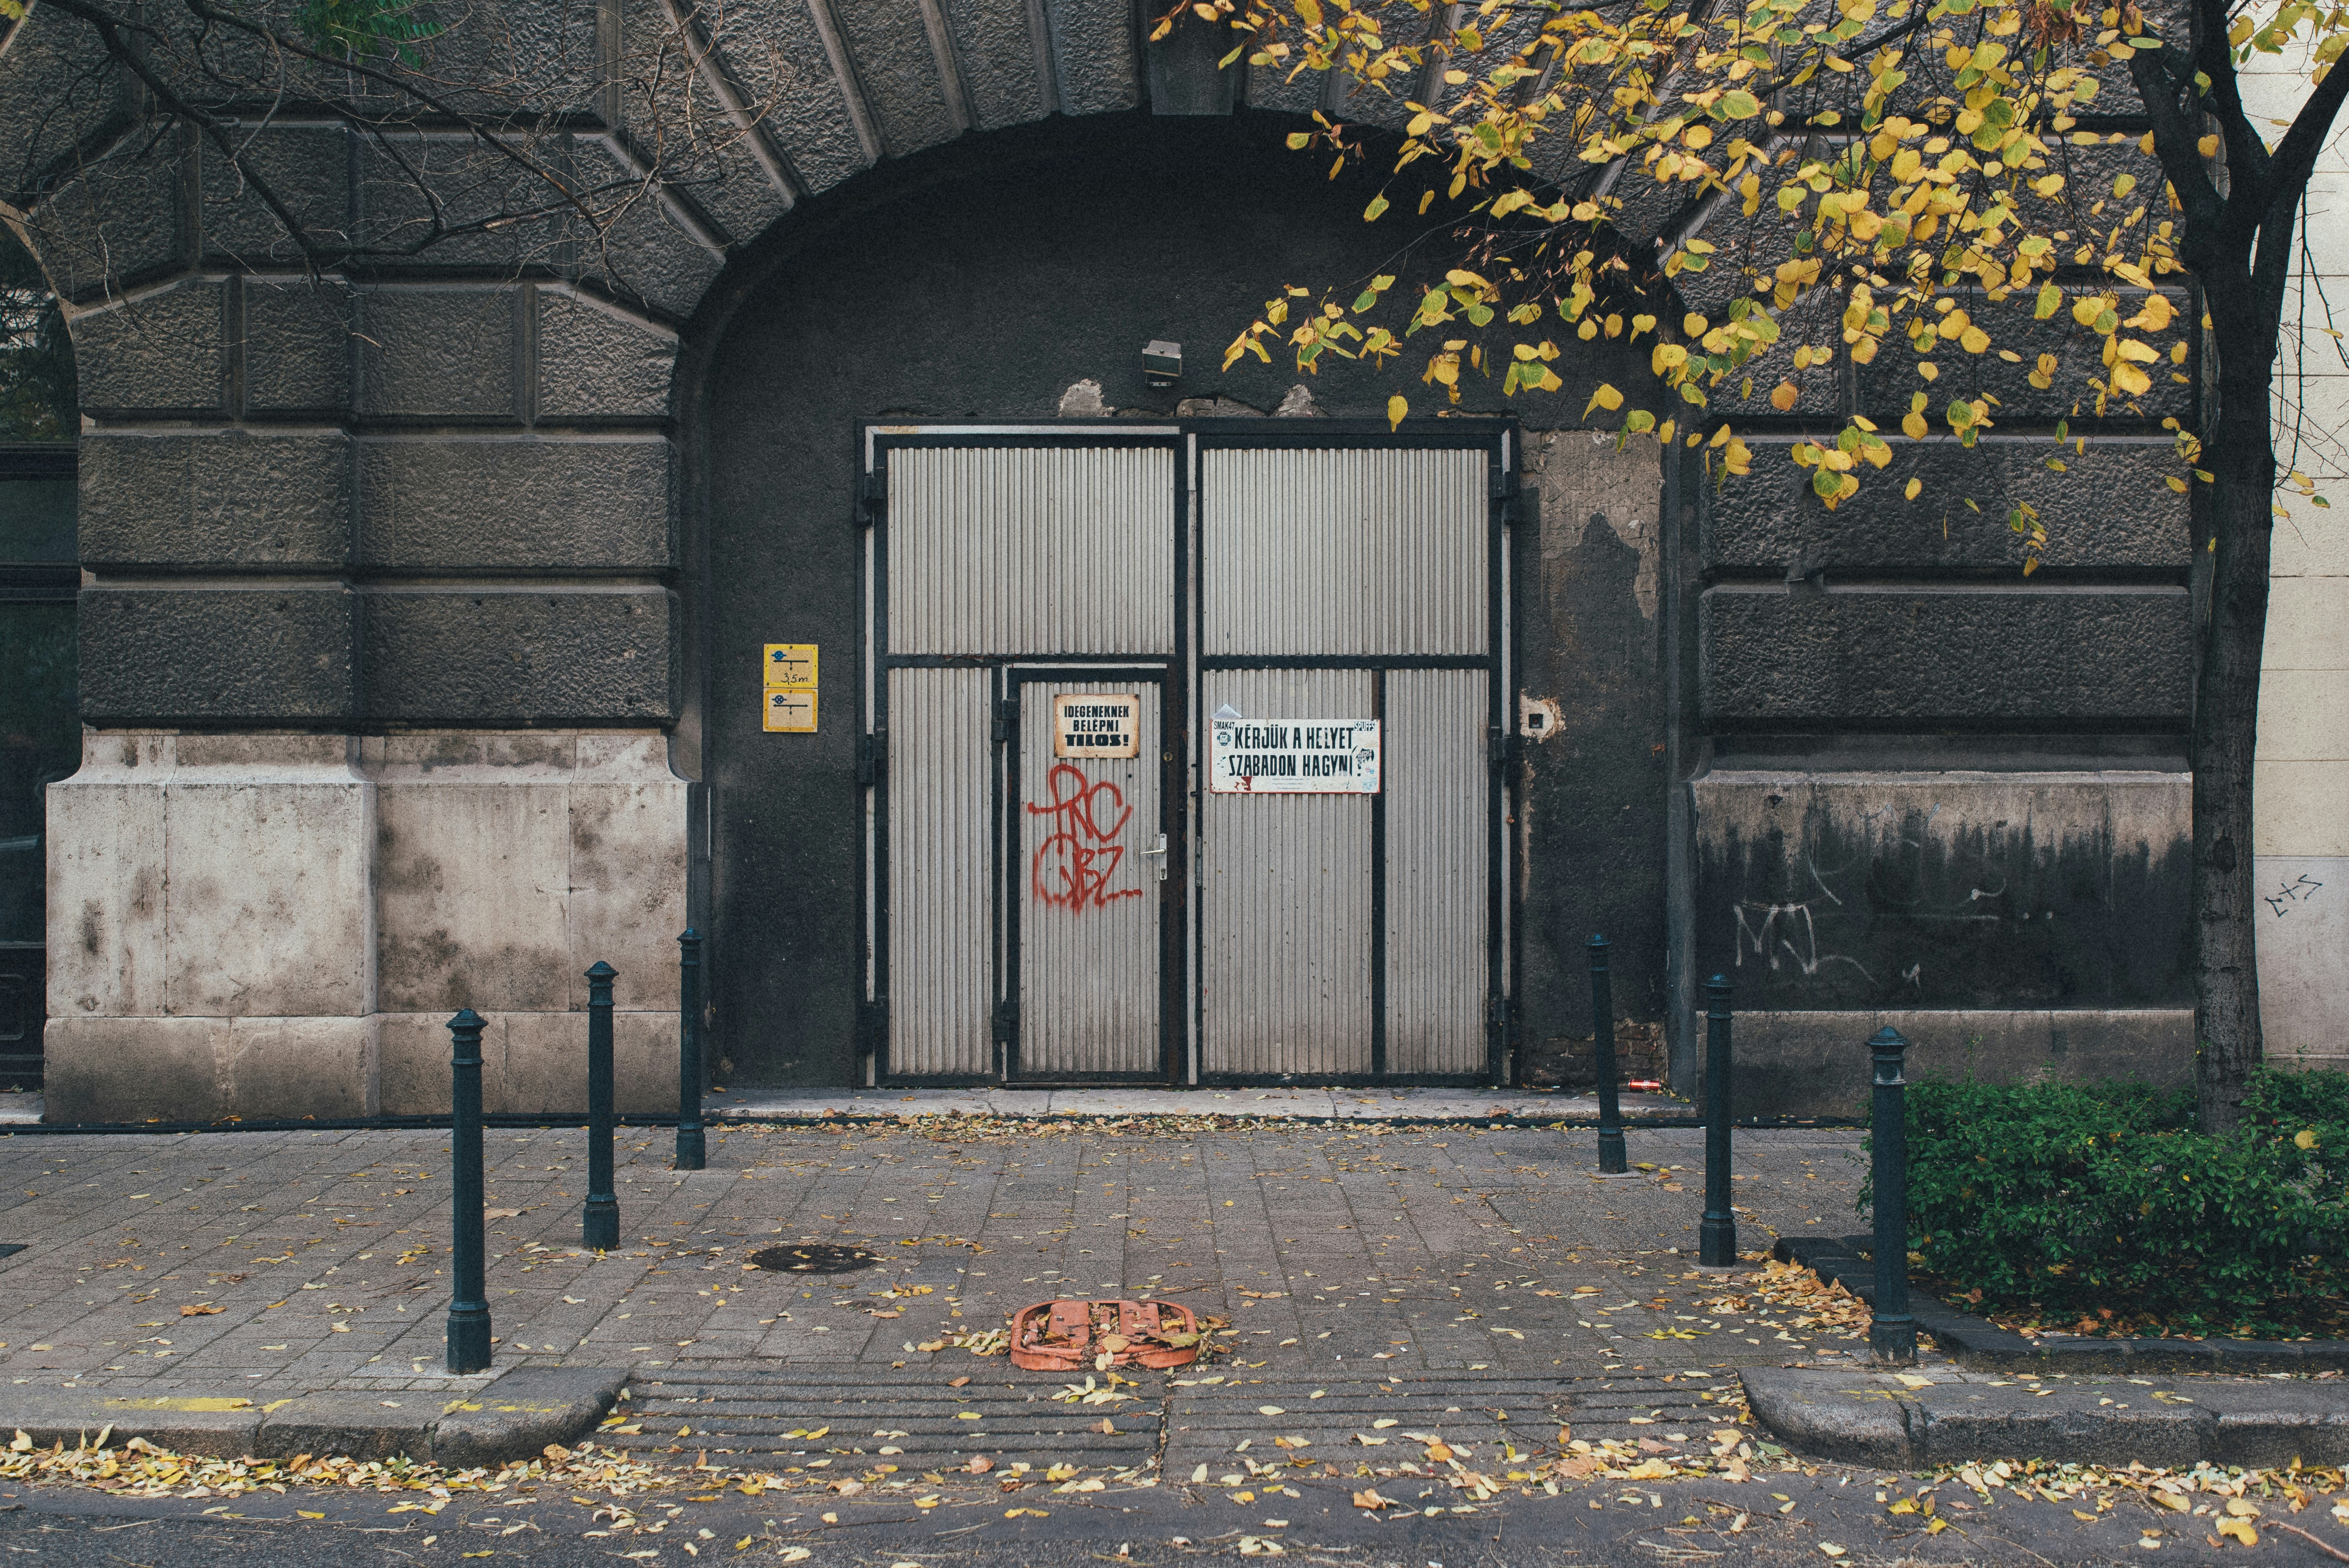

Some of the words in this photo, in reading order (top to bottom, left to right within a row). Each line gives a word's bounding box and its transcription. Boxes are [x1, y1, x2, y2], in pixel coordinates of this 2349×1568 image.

[1064, 706, 1129, 718] IDEGENEKNEK
[1073, 718, 1119, 732] BELÉPNI
[1214, 721, 1235, 730] SMAK47
[1354, 721, 1375, 731] SPUFFS
[1234, 724, 1288, 749] KÉRJÜK
[1292, 727, 1302, 749] A
[1307, 727, 1354, 749] HELYET
[1228, 755, 1296, 776] SZABADON
